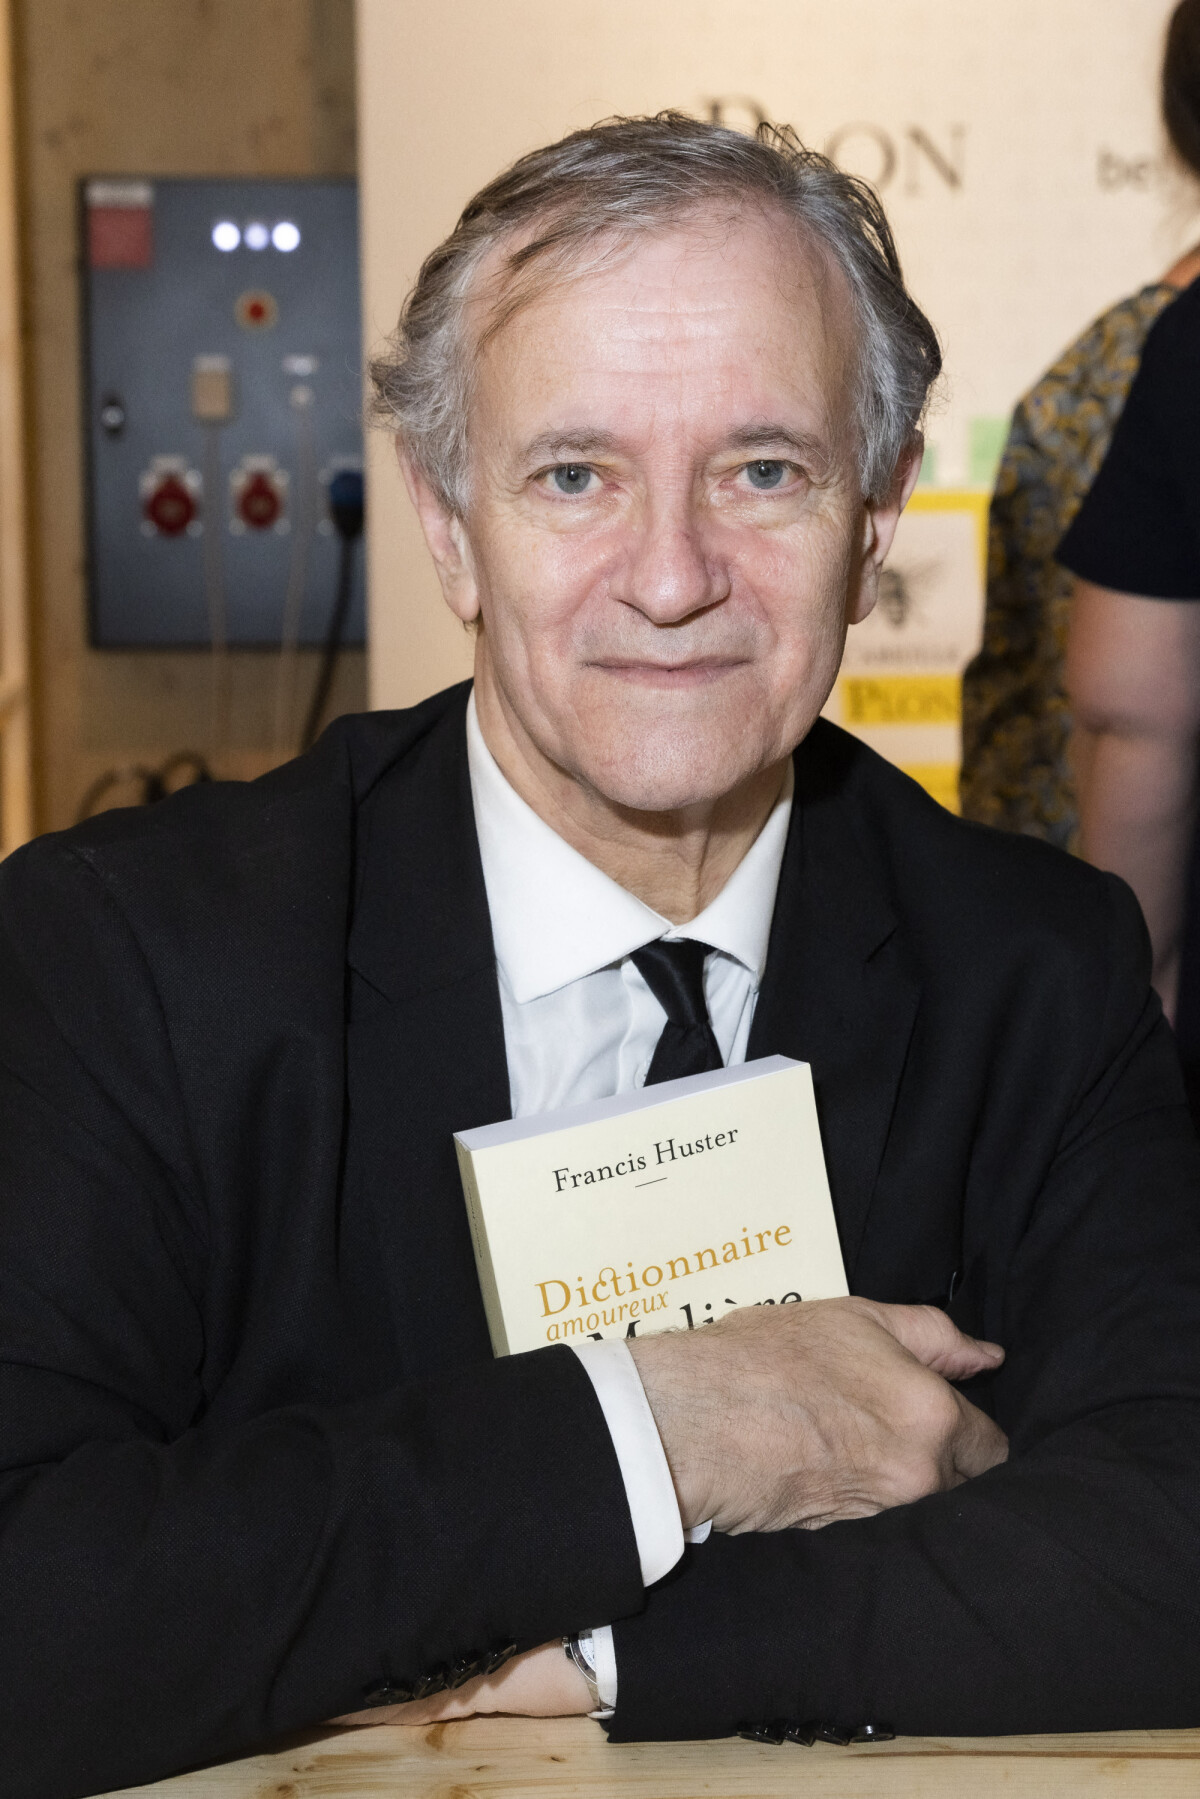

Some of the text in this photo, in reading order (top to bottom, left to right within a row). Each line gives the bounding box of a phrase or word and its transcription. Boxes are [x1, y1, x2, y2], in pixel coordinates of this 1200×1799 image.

[552, 1127, 739, 1193] Francis Huster
[534, 1224, 794, 1319] Dictionnaire
[546, 1289, 669, 1342] amoureux
